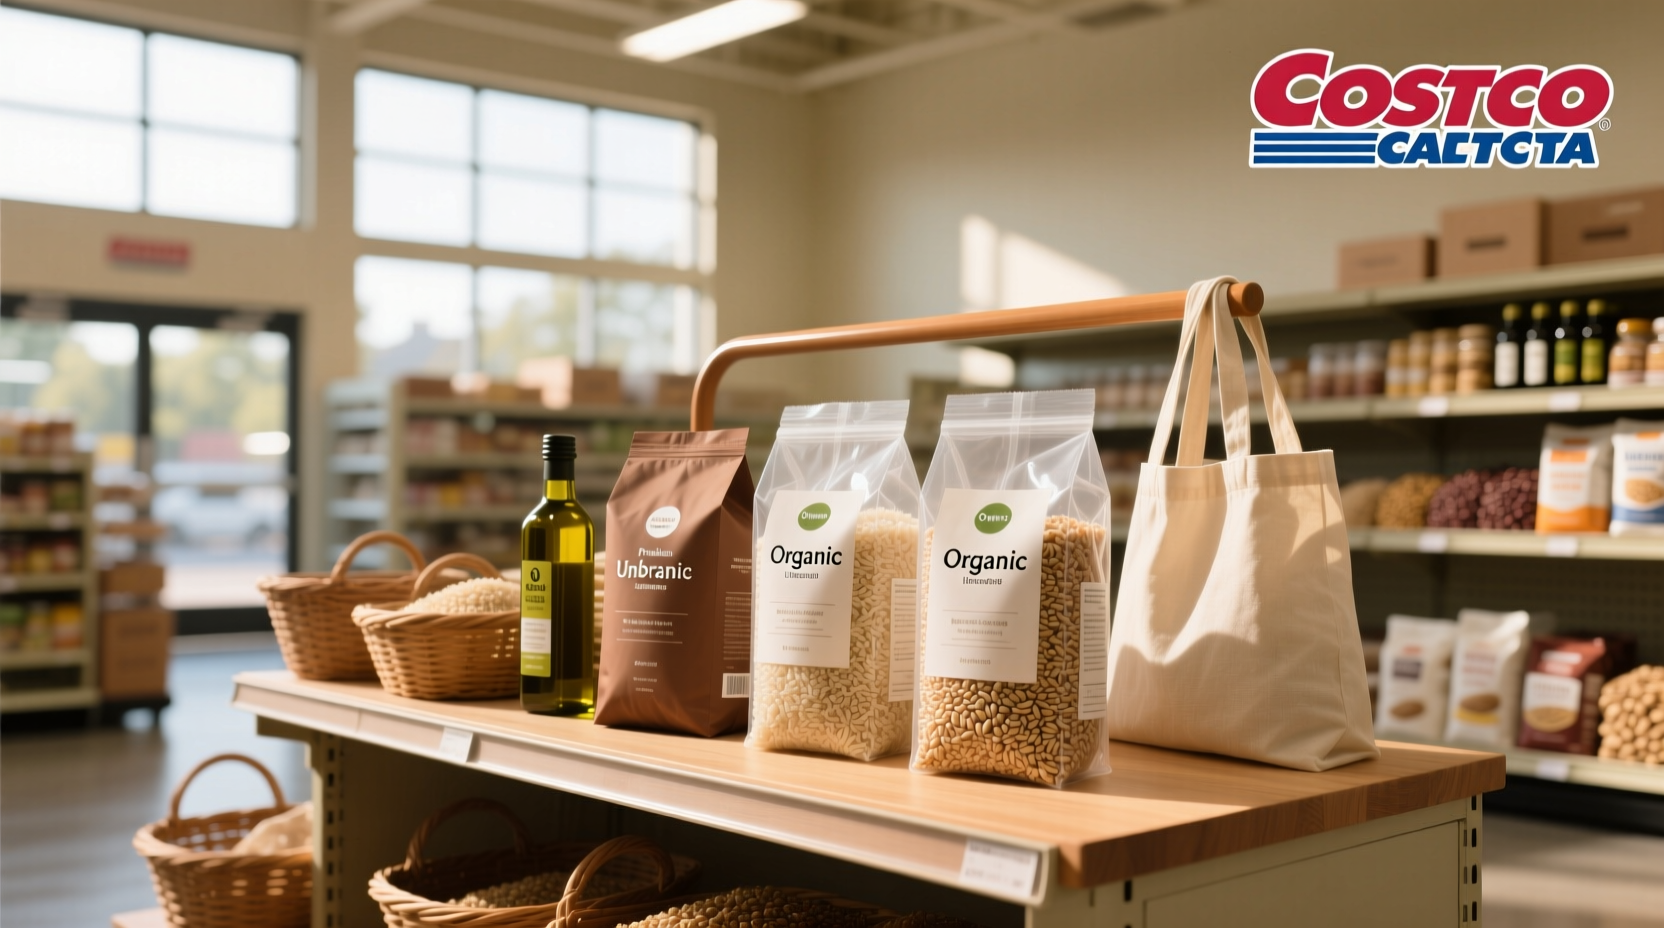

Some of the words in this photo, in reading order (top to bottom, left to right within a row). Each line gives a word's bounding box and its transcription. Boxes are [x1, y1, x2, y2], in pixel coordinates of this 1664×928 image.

[616, 559, 693, 580] Unbranic
[770, 544, 843, 570] Organic
[943, 548, 1028, 576] Organic
